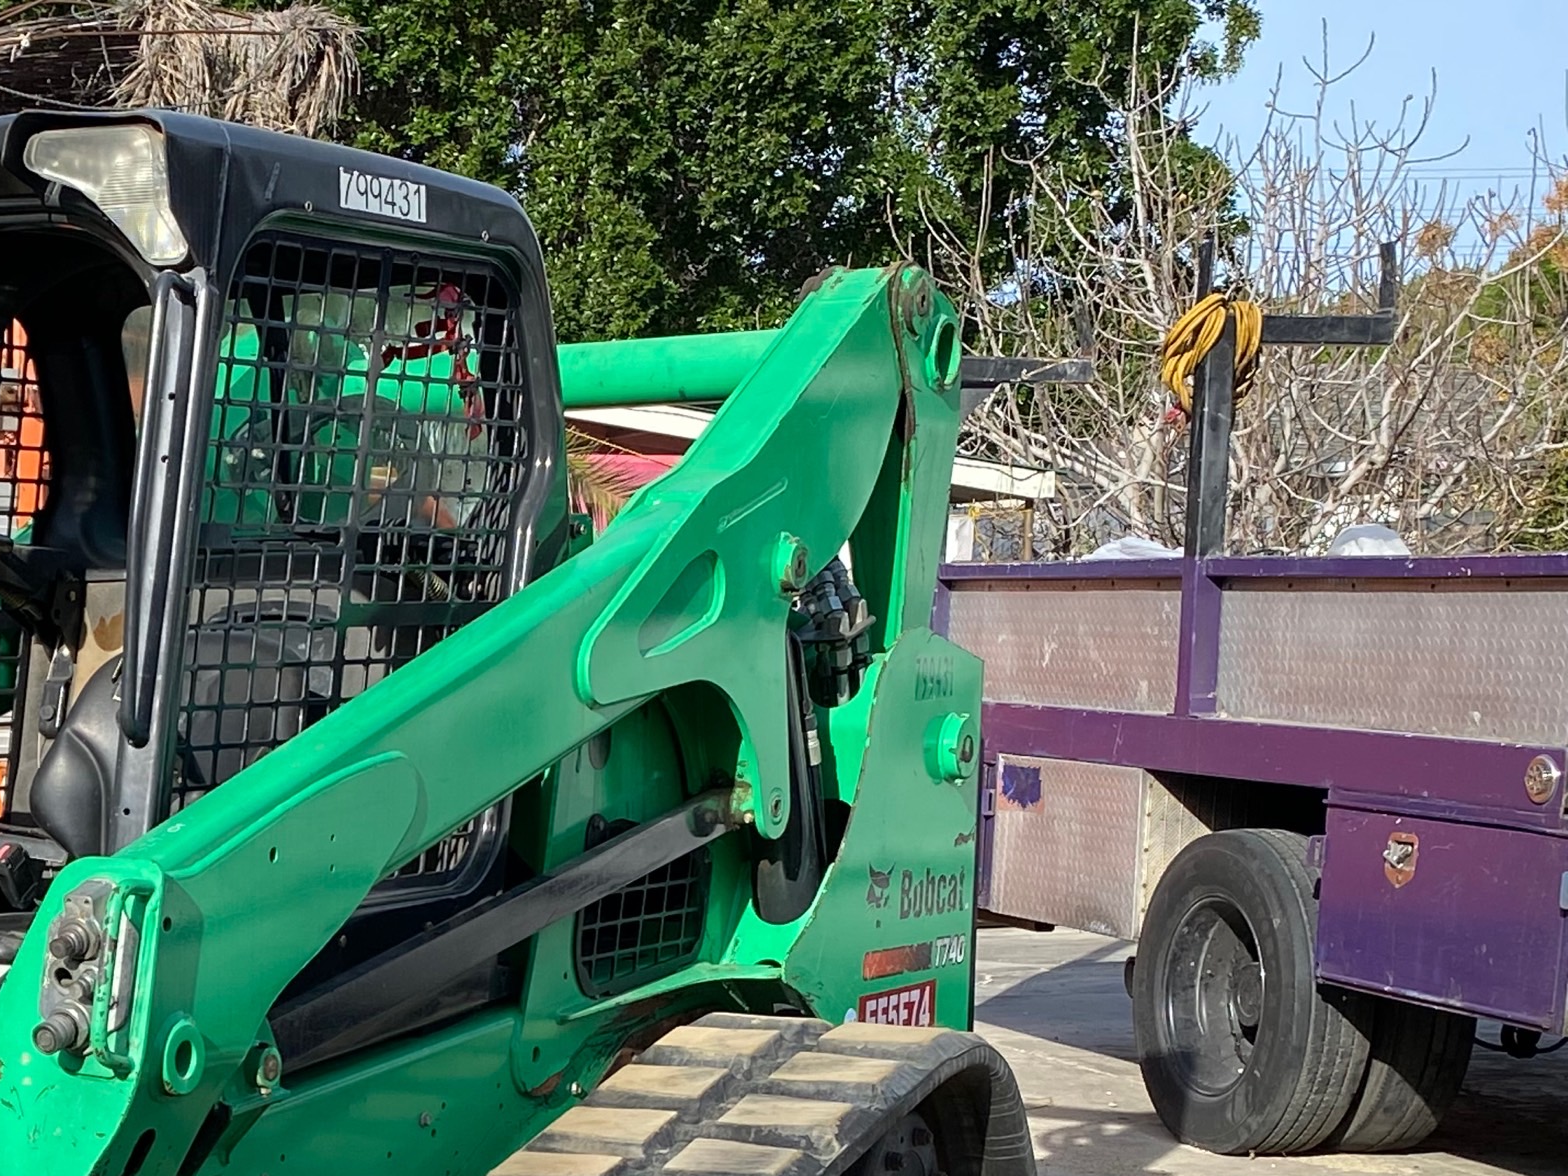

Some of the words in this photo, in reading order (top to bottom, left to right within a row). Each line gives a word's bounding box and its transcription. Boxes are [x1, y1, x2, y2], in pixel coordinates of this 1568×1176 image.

[343, 171, 421, 219] 799431
[899, 865, 965, 920] Bobcat
[935, 934, 966, 968] T740
